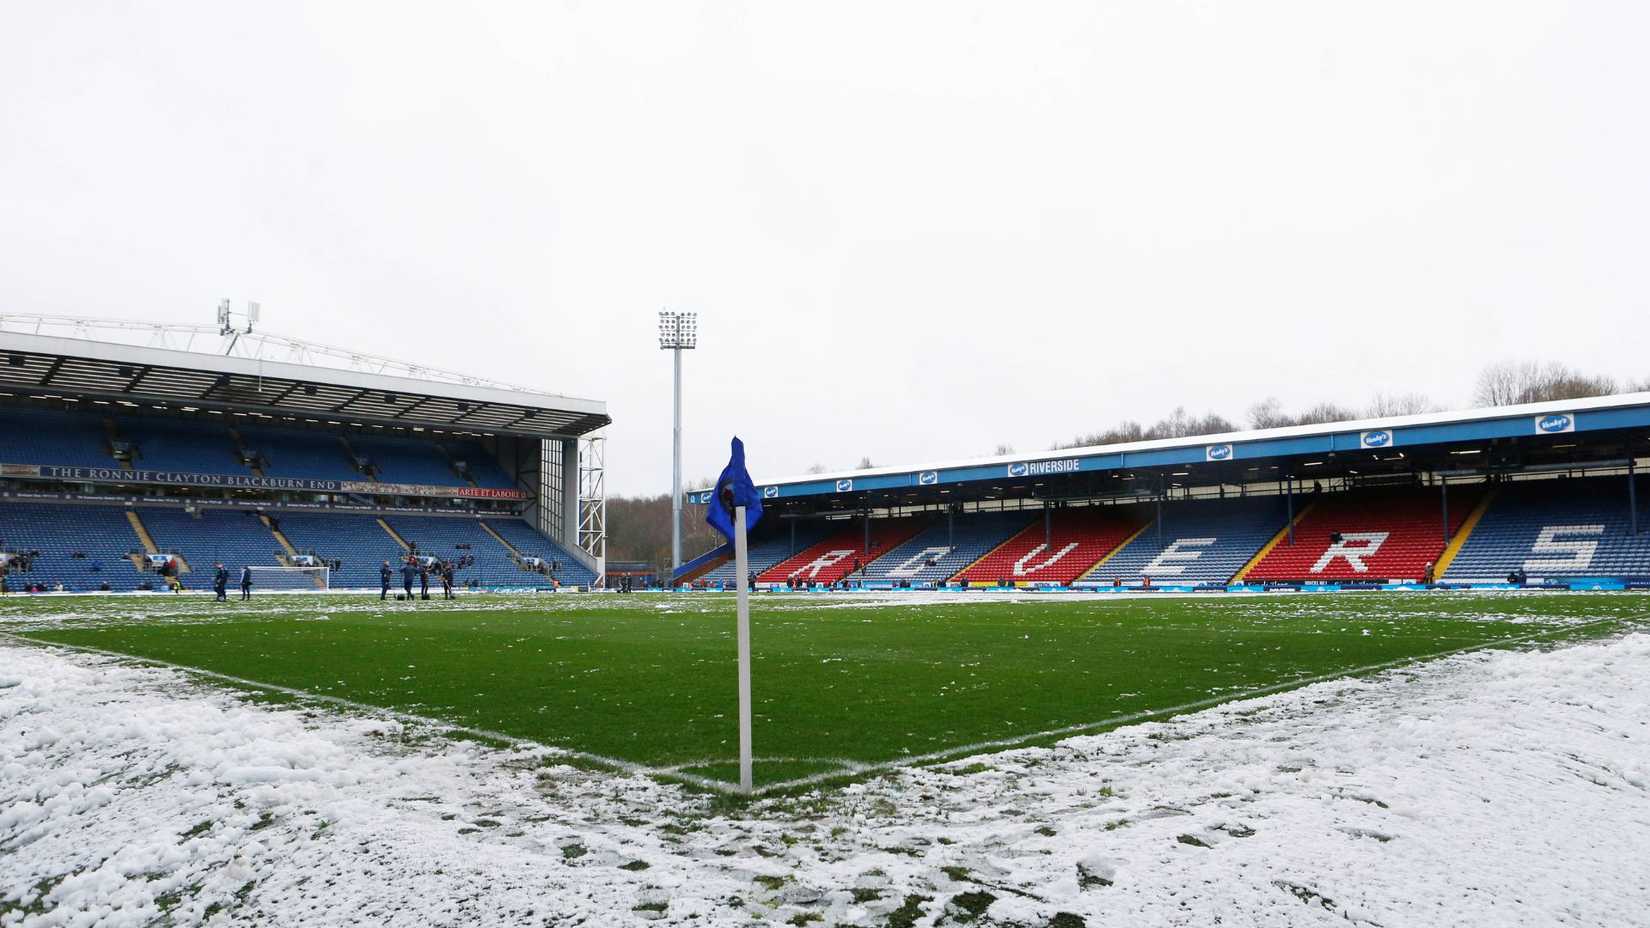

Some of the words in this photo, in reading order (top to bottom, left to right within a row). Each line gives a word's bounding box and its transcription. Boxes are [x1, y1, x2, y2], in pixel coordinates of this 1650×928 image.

[1030, 459, 1080, 474] RIVERSIDE
[49, 467, 81, 478] THE
[89, 469, 149, 481] RONNIE
[156, 472, 221, 484] CLAYTON
[227, 476, 304, 488] BLACKBURN
[310, 480, 336, 490] END
[459, 488, 480, 497] ARTE
[481, 489, 490, 497] ET
